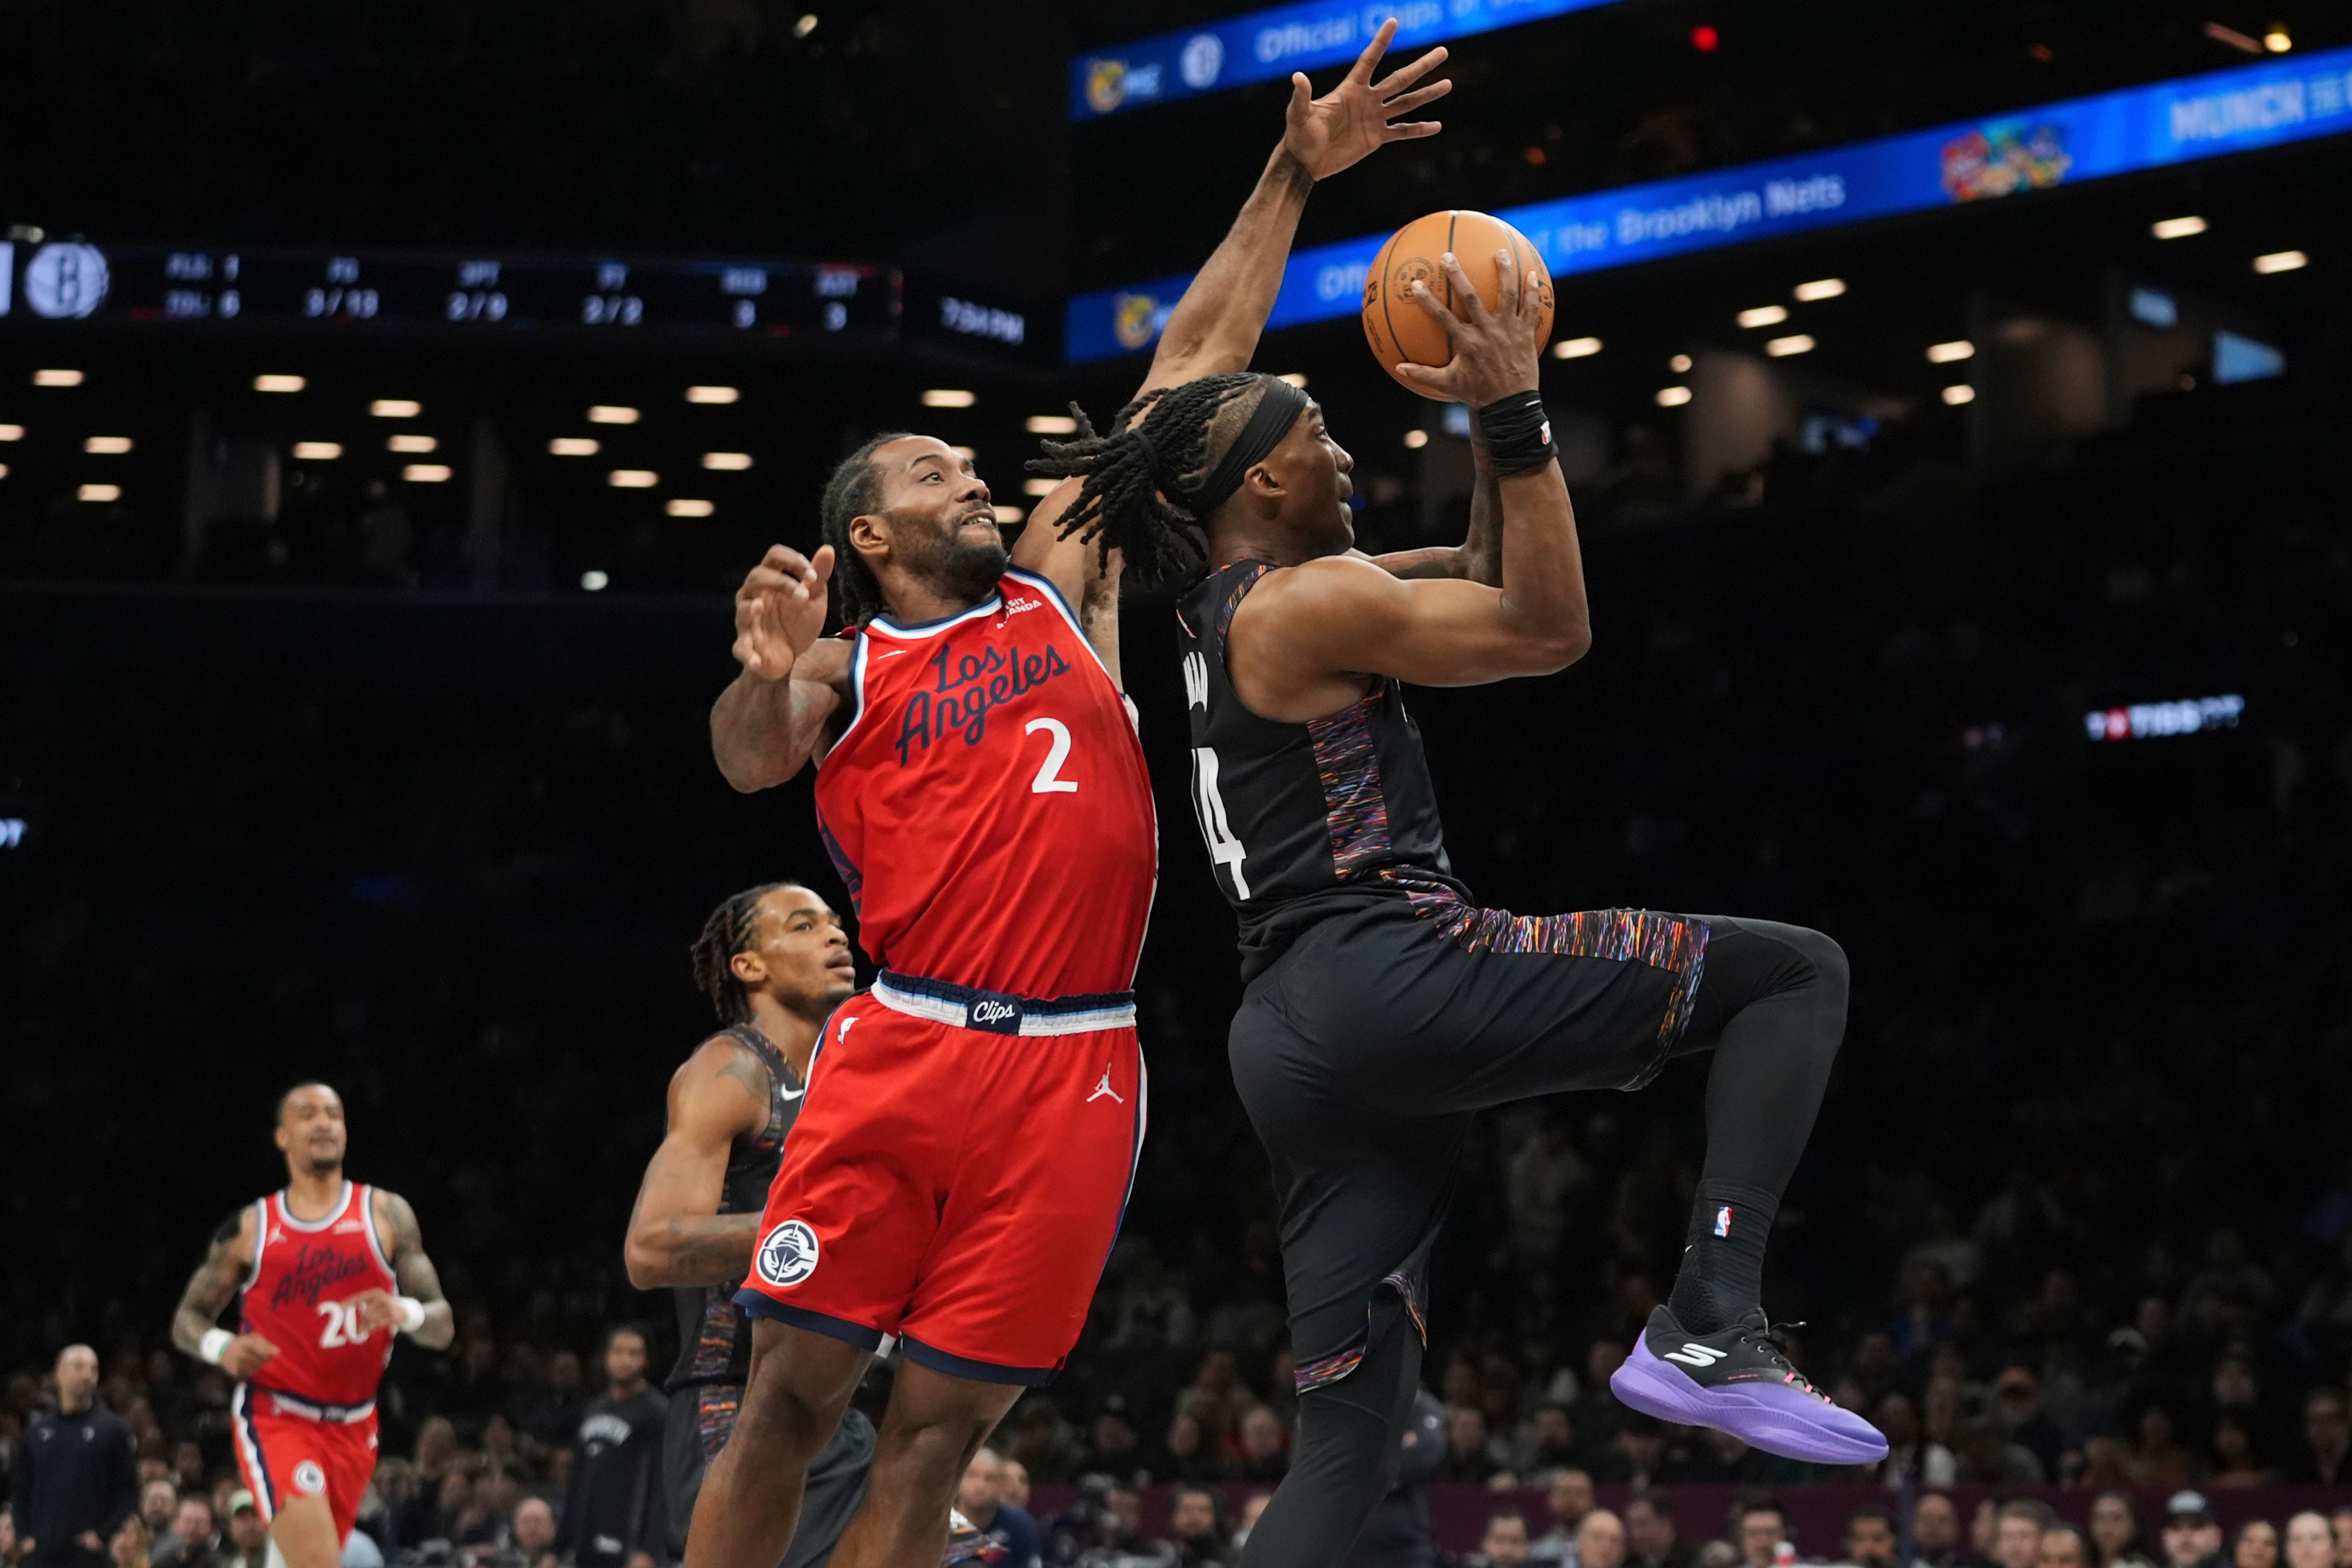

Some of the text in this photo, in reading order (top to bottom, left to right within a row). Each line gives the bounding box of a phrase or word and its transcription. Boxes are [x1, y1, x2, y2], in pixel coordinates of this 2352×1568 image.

[1254, 19, 1357, 63] Official
[2171, 82, 2304, 140] MUNCH
[1559, 222, 1609, 253] the
[1615, 191, 1762, 246] Brooklyn
[1764, 174, 1846, 217] Nets
[1005, 597, 1026, 610] SIT
[931, 643, 1006, 694] Los
[895, 645, 1071, 769] Angeles
[1025, 717, 1079, 793] 2
[973, 1001, 1016, 1025] Clips
[271, 1252, 368, 1312] Angeles
[296, 1242, 337, 1276] Los
